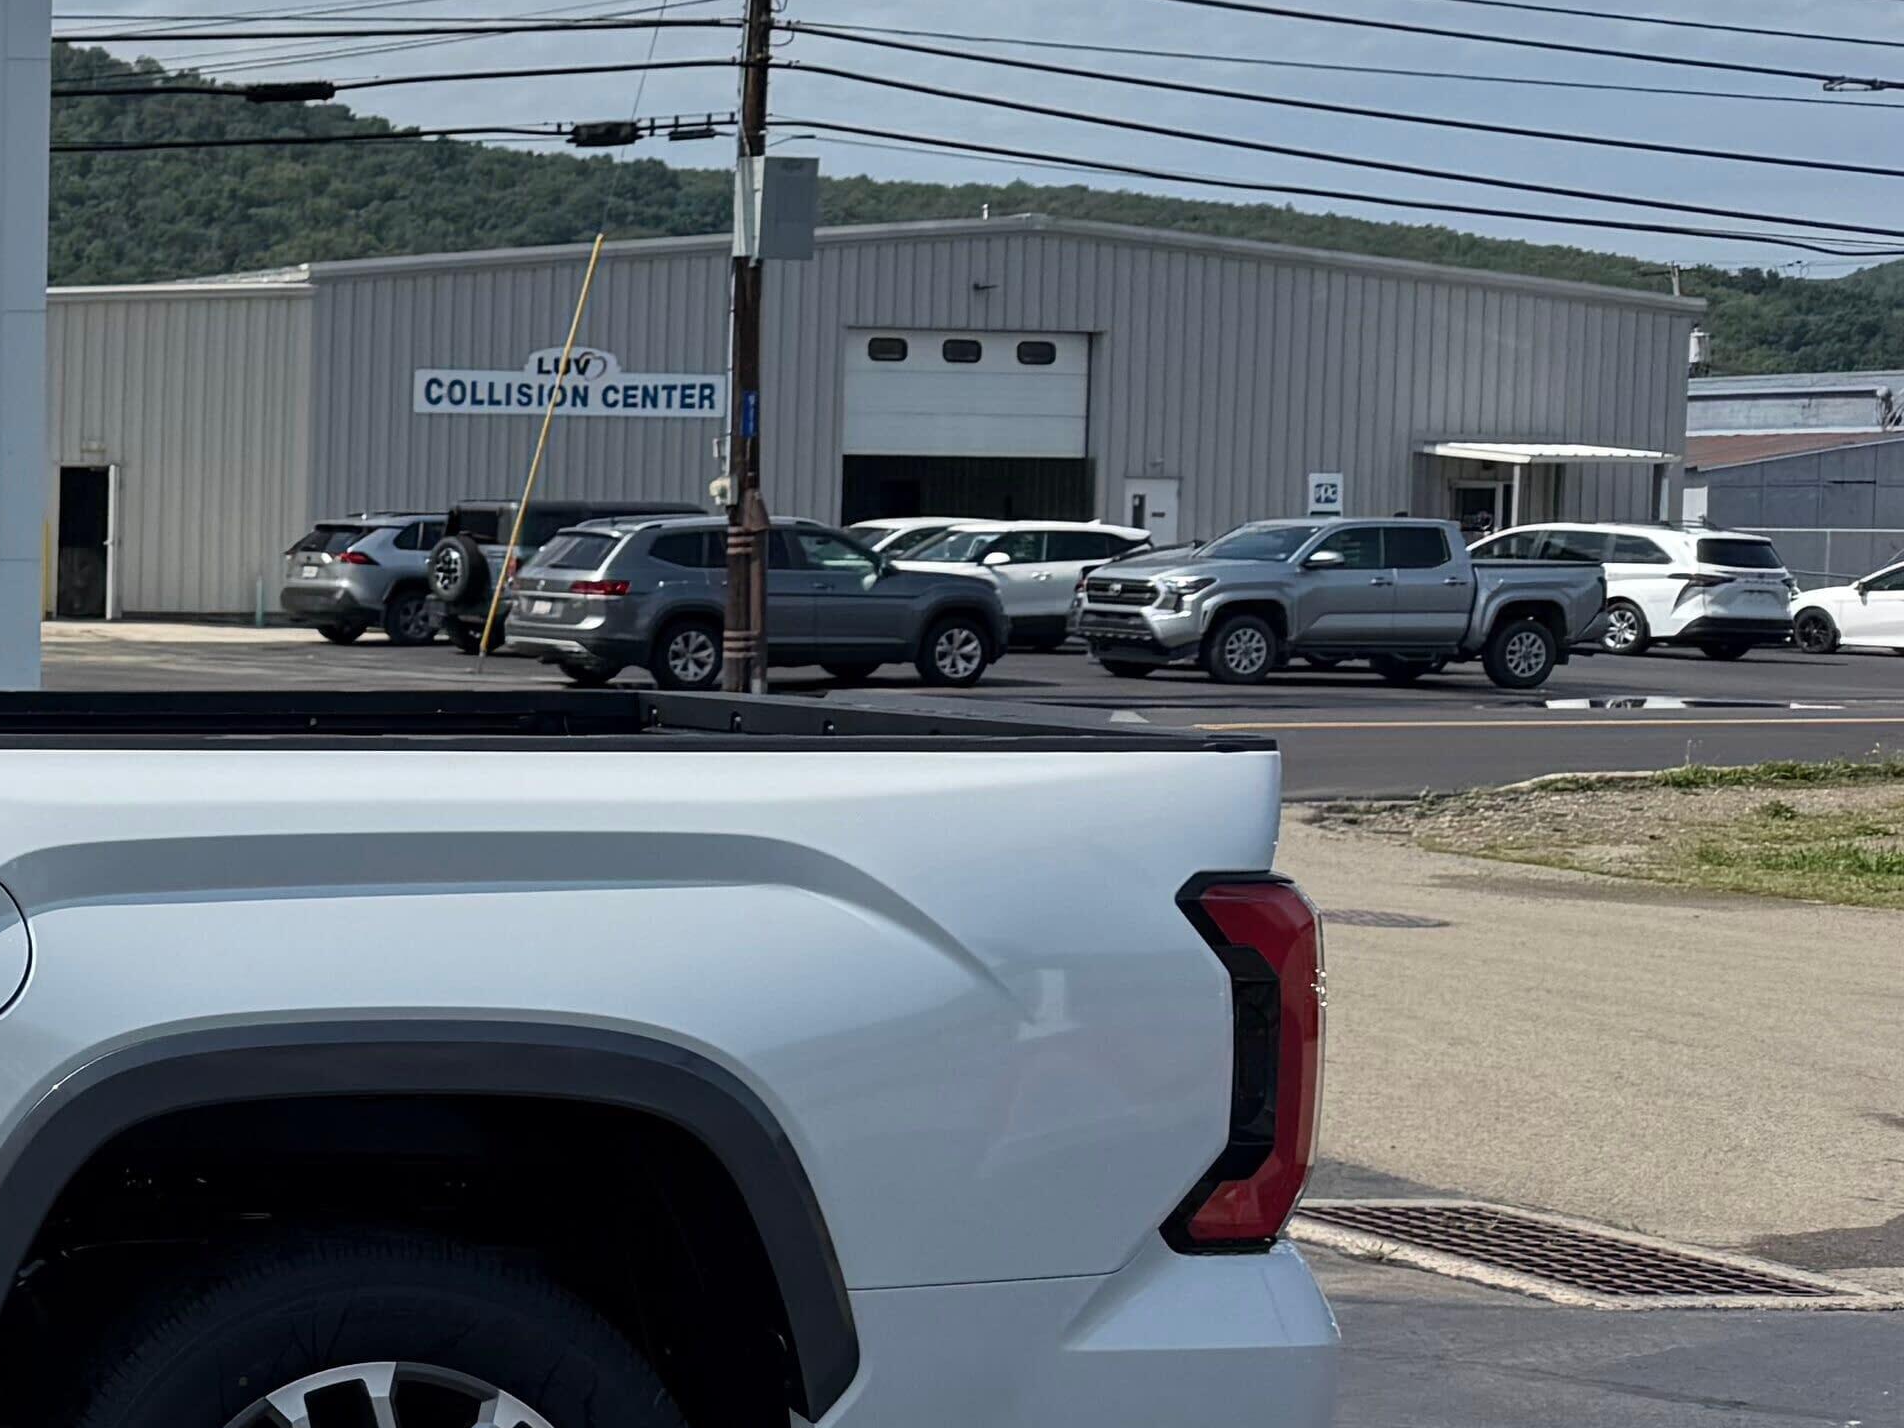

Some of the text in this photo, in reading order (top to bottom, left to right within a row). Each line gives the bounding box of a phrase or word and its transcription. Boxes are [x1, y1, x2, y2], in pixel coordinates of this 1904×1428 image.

[537, 356, 591, 376] LUV
[424, 377, 715, 410] COLLISION CENTER
